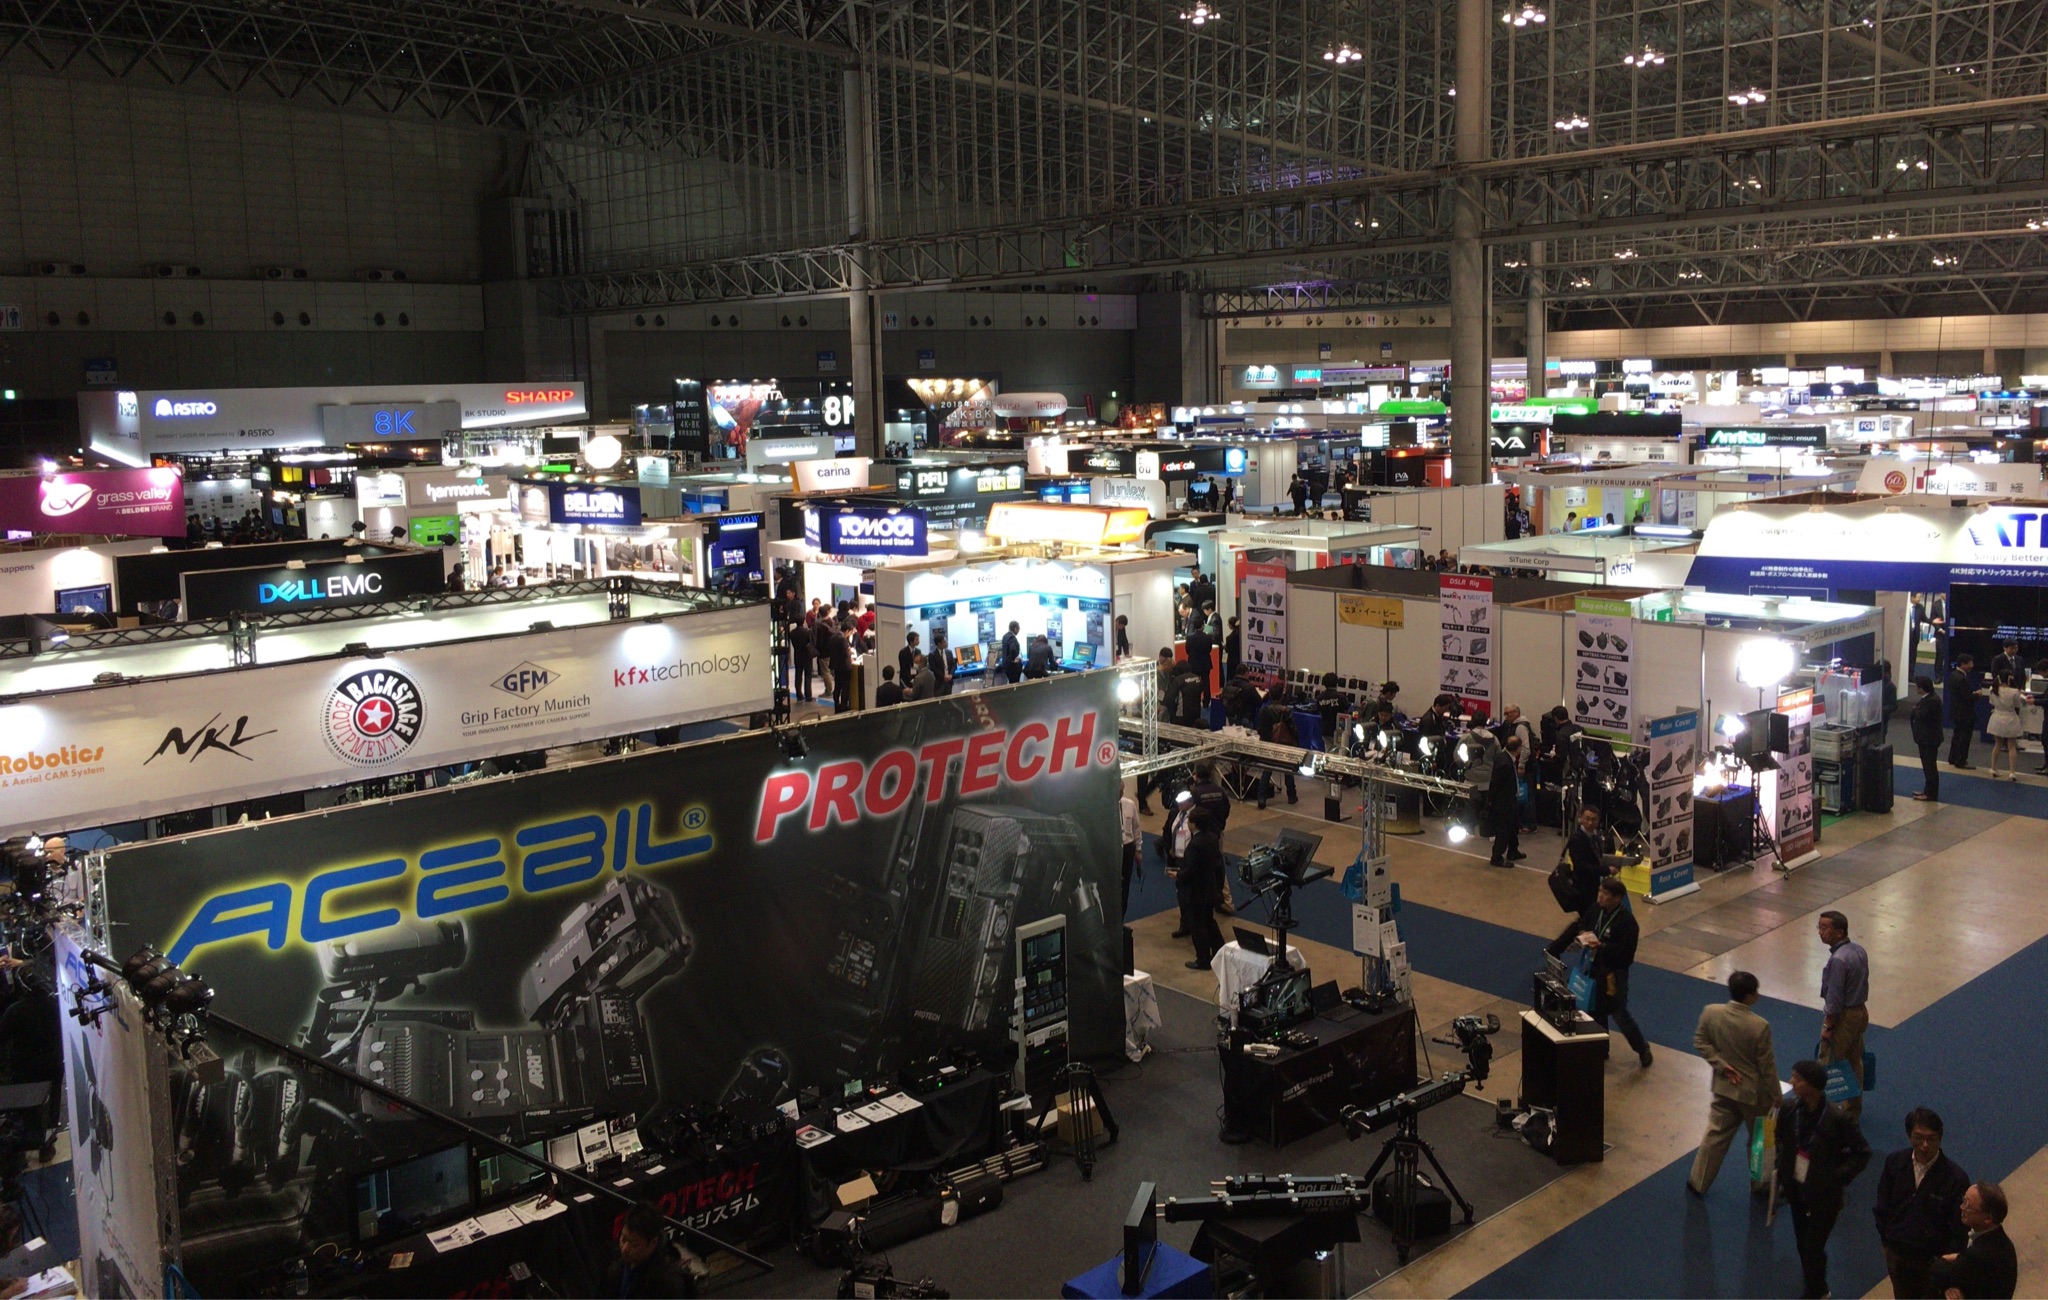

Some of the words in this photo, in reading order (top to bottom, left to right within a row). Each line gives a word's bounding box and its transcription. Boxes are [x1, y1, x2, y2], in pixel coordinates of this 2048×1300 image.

[506, 389, 575, 404] SHARP
[174, 401, 217, 416] ASTRO
[465, 410, 476, 418] 8K
[477, 409, 507, 417] STUDIO
[373, 410, 416, 435] 8K
[247, 428, 275, 438] ASTRO
[1711, 429, 1767, 445] Anritsu
[817, 466, 851, 479] carina
[1161, 460, 1196, 472] ActiveScale
[918, 471, 949, 488] PFU
[1582, 478, 1598, 486] IPTV
[1600, 479, 1626, 487] FORUM
[1628, 480, 1651, 488] JAPAN
[96, 490, 135, 506] grass
[135, 487, 173, 502] valley
[426, 478, 492, 502] harmonic
[121, 506, 150, 515] BELDEN
[150, 504, 174, 513] BRAND
[564, 492, 624, 513] BELDEN
[718, 515, 760, 526] WOWOW
[838, 518, 915, 537] TOMOCA
[839, 537, 881, 547] Broadcasting
[881, 538, 893, 546] and
[893, 538, 914, 546] Studio
[1249, 536, 1267, 545] Mobile
[1267, 537, 1294, 546] Viewpoint
[1508, 556, 1532, 565] SiTune
[1533, 558, 1550, 567] Corp
[2011, 553, 2044, 562] Better
[1609, 562, 1633, 577] ATEN
[258, 578, 327, 604] DELL
[326, 573, 383, 598] EMC
[1448, 577, 1468, 588] DSLR
[1469, 578, 1480, 589] Rig
[1580, 600, 1595, 611] Bag
[1595, 602, 1608, 611] and
[1608, 603, 1626, 613] Case
[1382, 619, 1403, 627] 株式会社
[503, 670, 548, 693] GFM
[346, 672, 418, 737] BACKSTAGE
[460, 709, 489, 726] Grip
[493, 703, 540, 721] Factory
[544, 693, 591, 712] Munich
[1467, 700, 1478, 710] Rig
[332, 699, 399, 758] EQUIPMENT
[462, 730, 477, 738] YOUR
[478, 724, 509, 735] INNOVATIVE
[510, 721, 534, 731] PARTNER
[534, 719, 546, 727] FOR
[546, 715, 568, 724] CAMERA
[568, 711, 591, 721] SUPPORT
[1659, 722, 1673, 731] Rain
[1674, 718, 1692, 729] Cover
[0, 743, 105, 776] Robotics
[2, 777, 9, 788] &
[11, 773, 43, 788] Aerial
[44, 769, 69, 783] CAM
[70, 765, 106, 782] System
[1658, 873, 1672, 884] Rain
[1673, 868, 1689, 881] Cover
[547, 928, 586, 968] PROTECH
[913, 1008, 941, 1023] PROTECH
[1282, 1069, 1335, 1098] antelope
[1415, 1082, 1452, 1106] PROTECH
[1300, 1195, 1351, 1208] PROTECH
